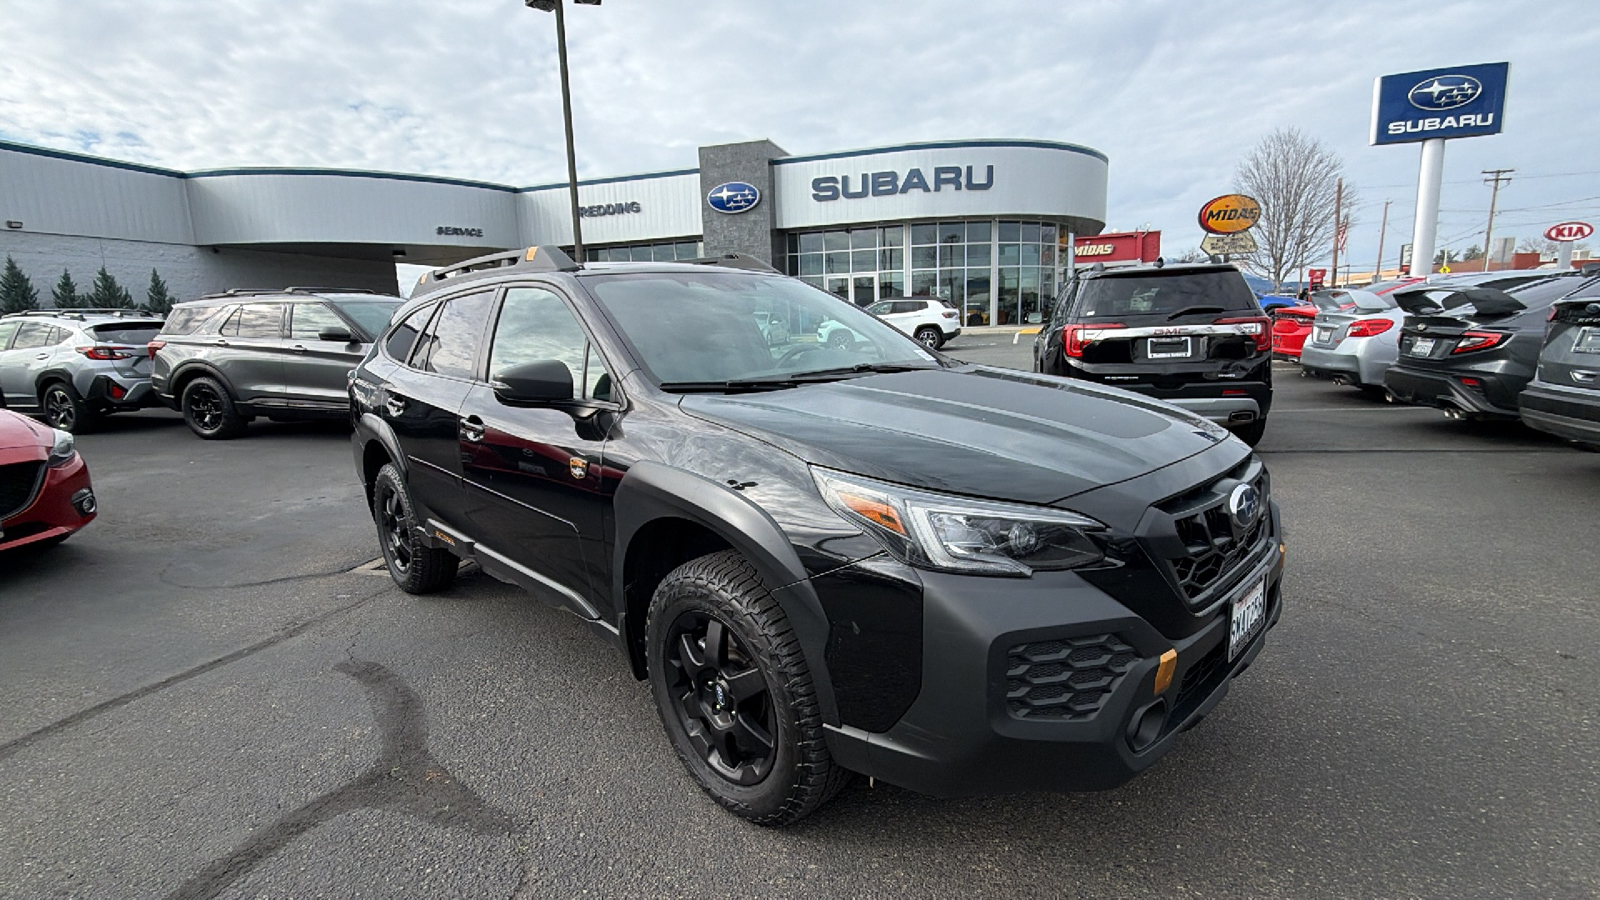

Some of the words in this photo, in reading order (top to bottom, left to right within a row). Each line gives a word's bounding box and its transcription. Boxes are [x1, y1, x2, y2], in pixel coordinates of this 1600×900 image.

[1388, 113, 1494, 134] SUBARU
[811, 164, 995, 202] SUBARU
[579, 201, 641, 218] REDDING
[1206, 204, 1259, 221] MIDAS
[436, 225, 484, 238] SERVICE
[1555, 226, 1586, 238] KIA
